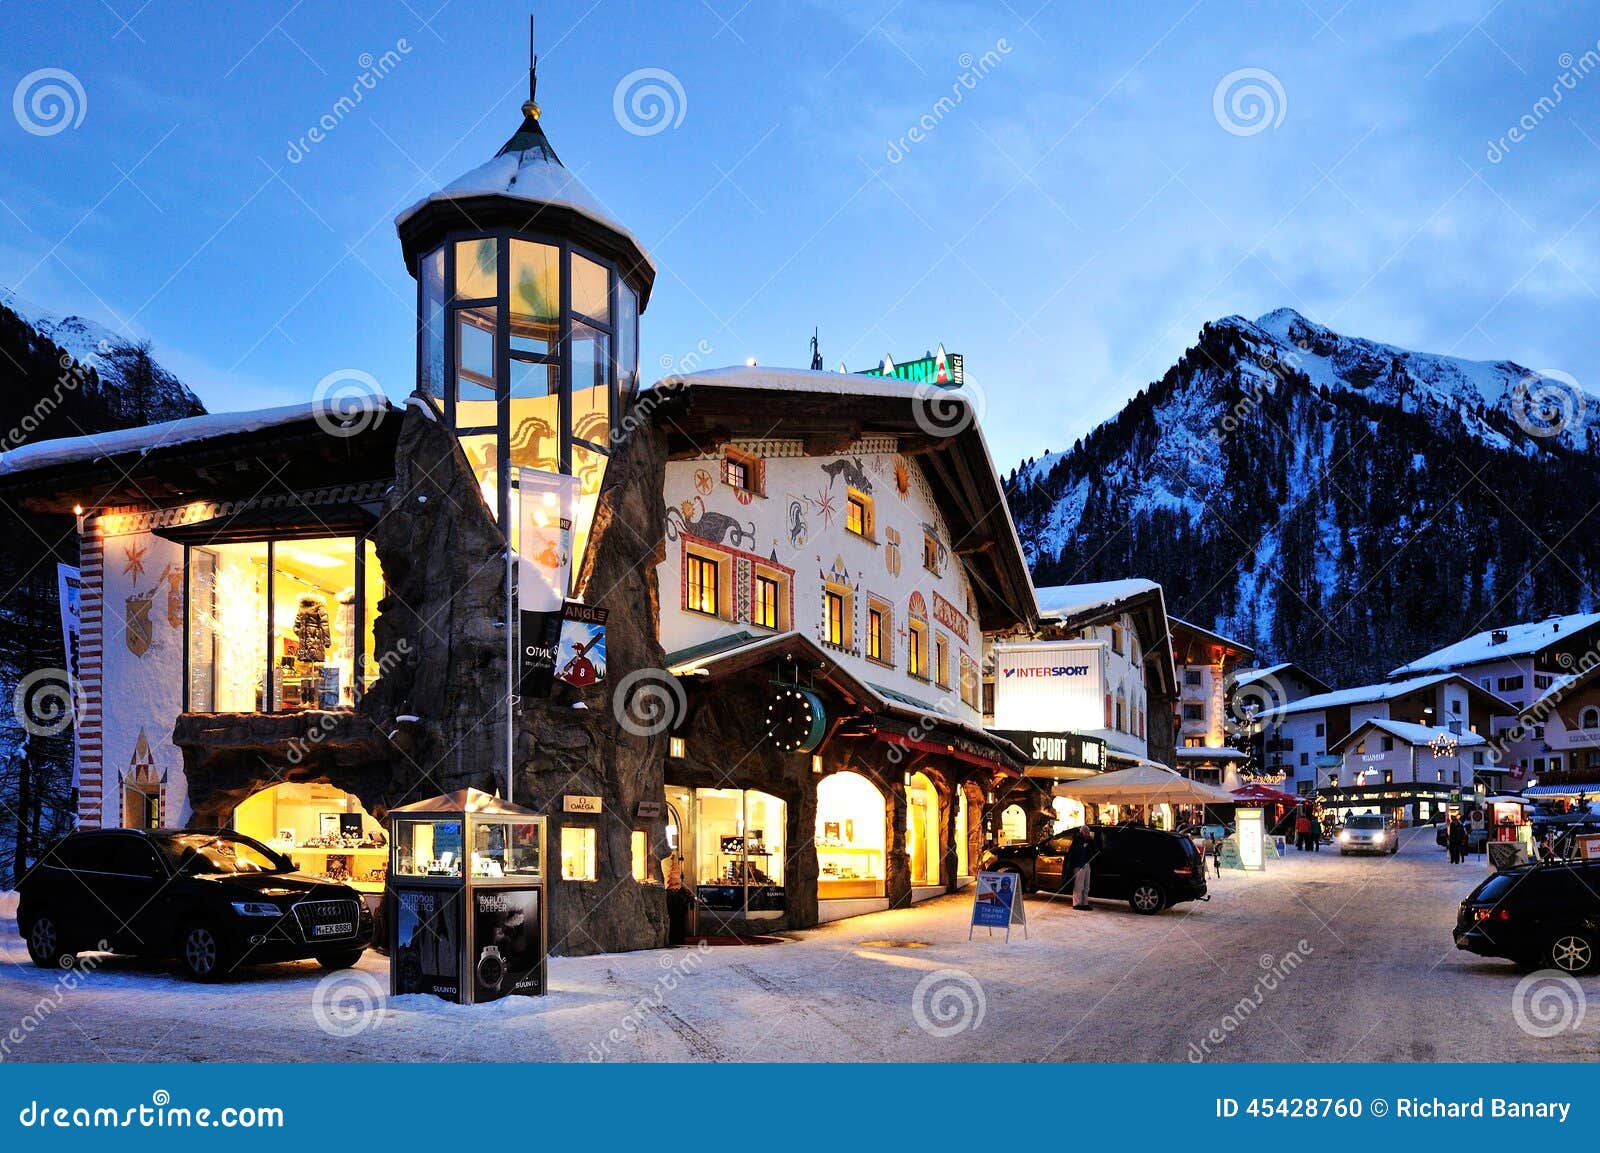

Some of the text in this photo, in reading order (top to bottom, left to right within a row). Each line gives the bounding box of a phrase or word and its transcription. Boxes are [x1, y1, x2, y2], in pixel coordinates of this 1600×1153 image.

[1016, 665, 1089, 678] INTERSPORT
[1032, 736, 1067, 761] SPORT
[479, 903, 508, 913] DEEPER
[432, 985, 458, 994] SUUNTO
